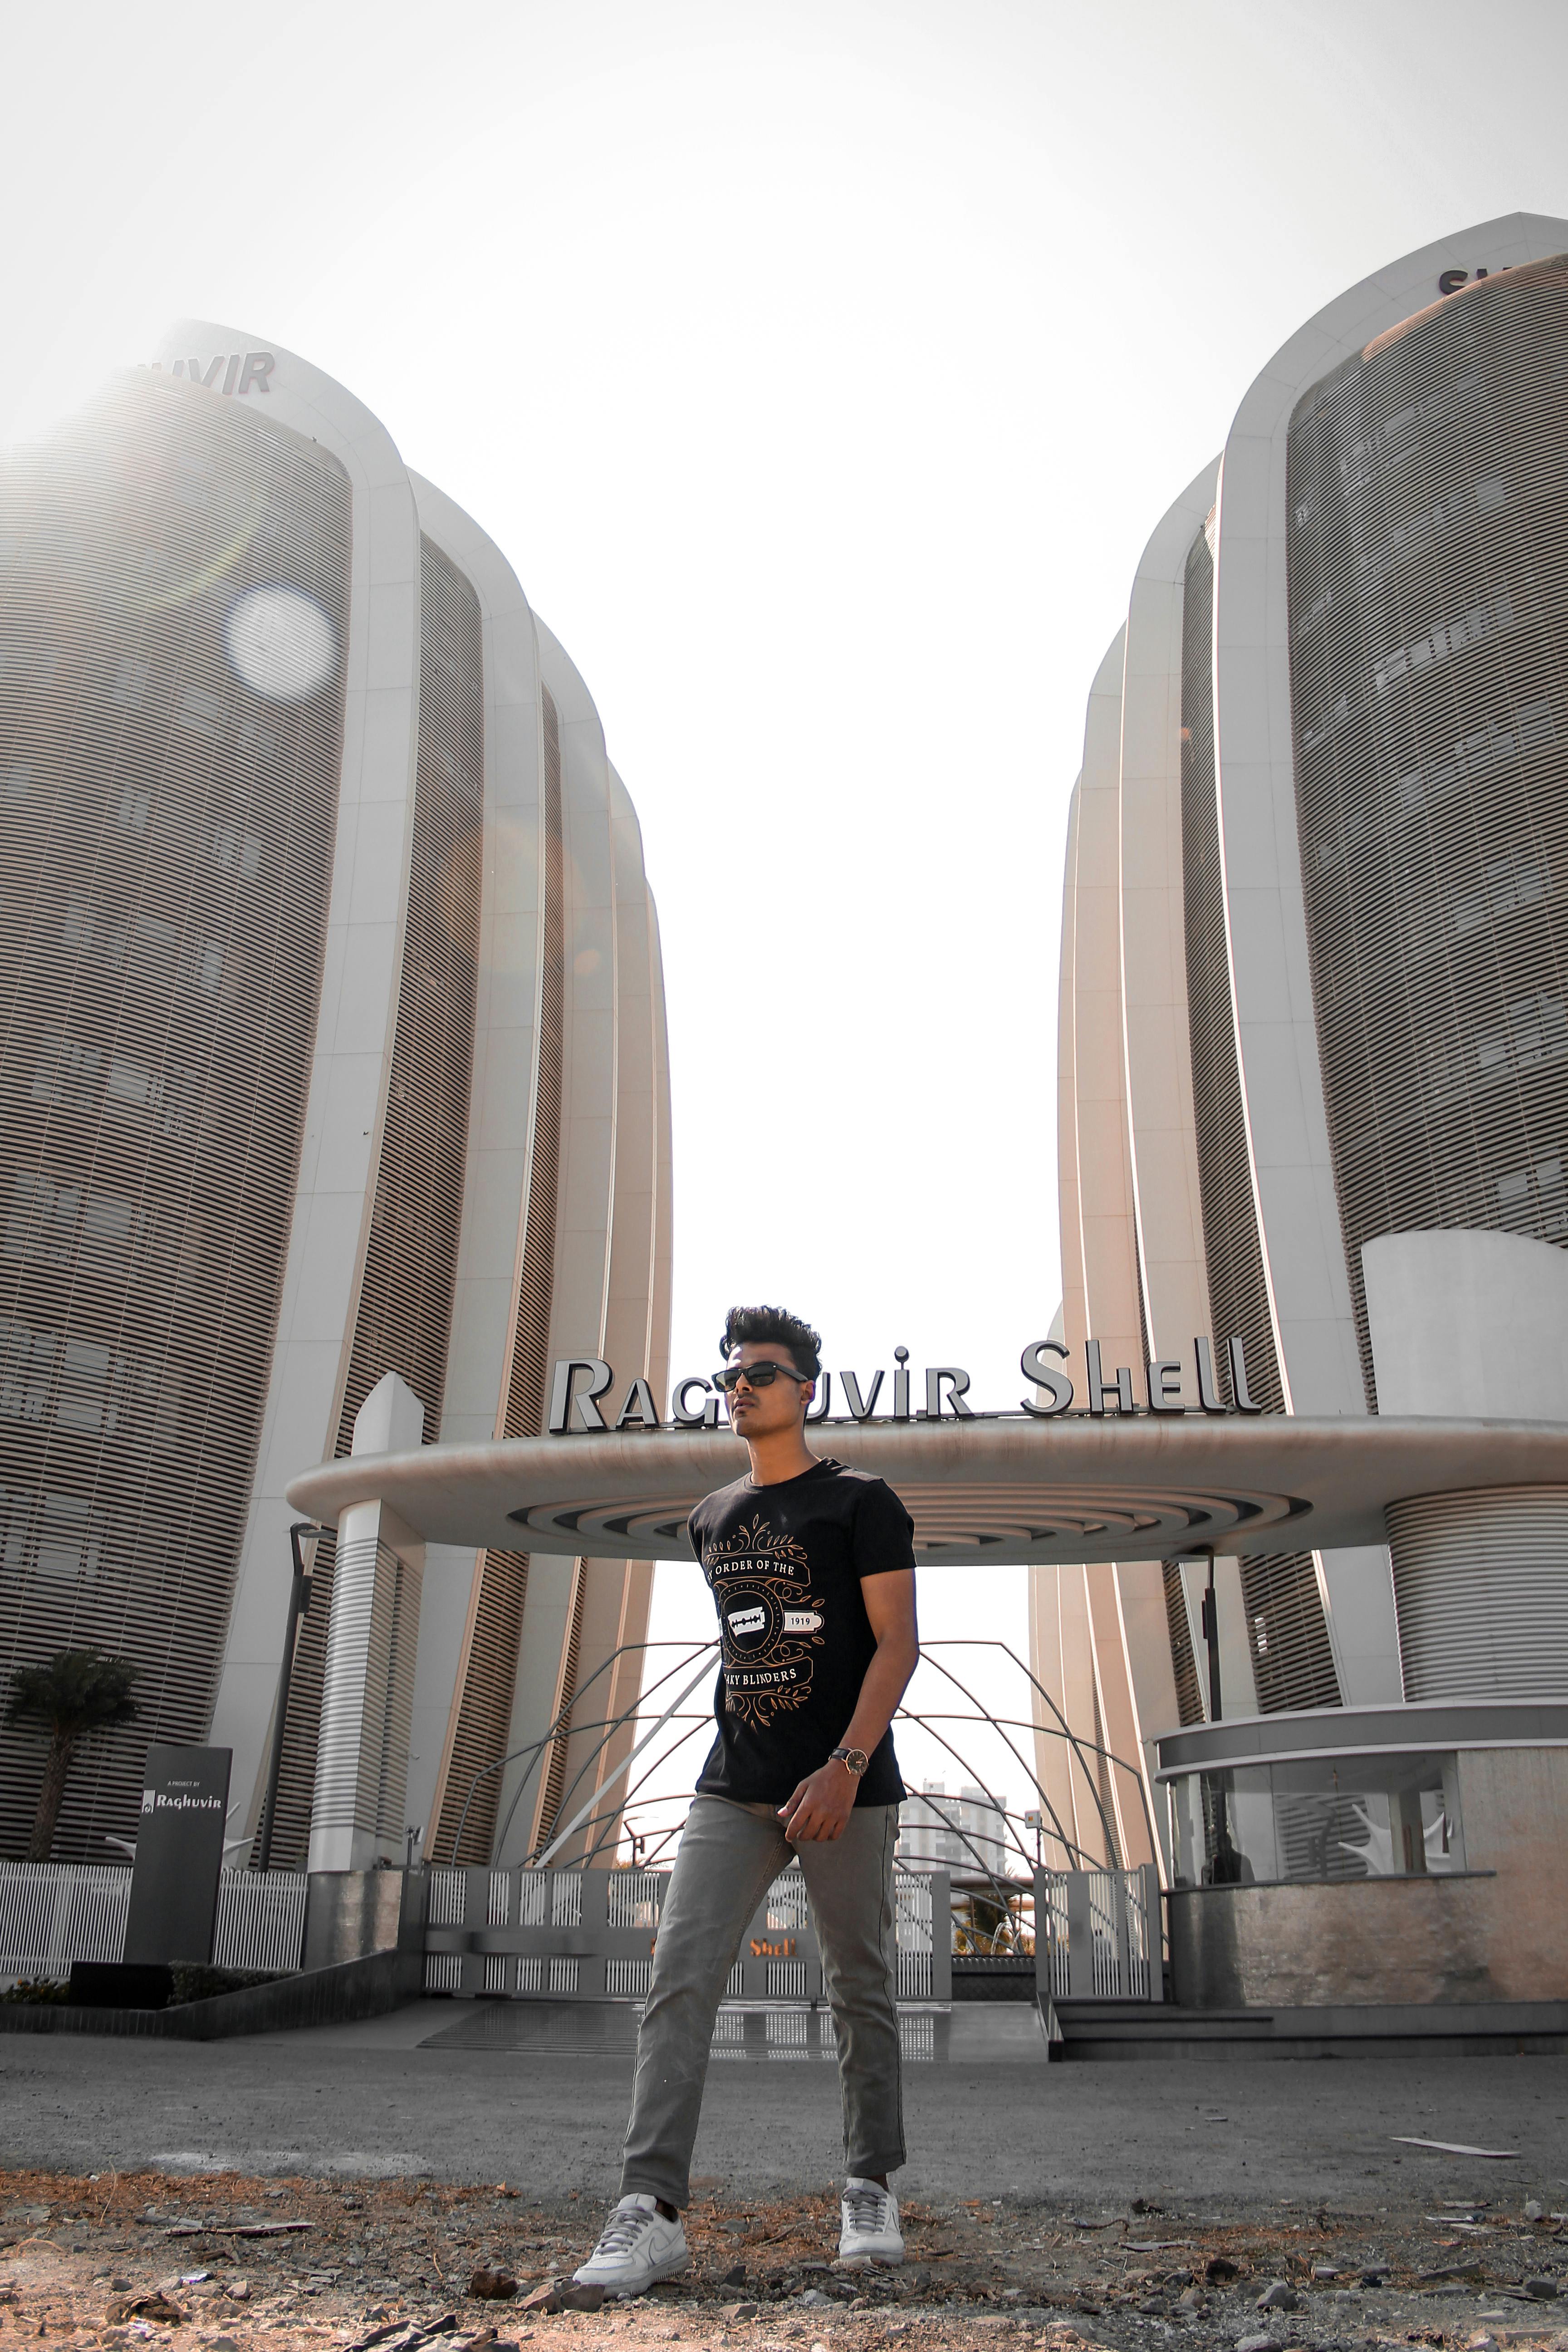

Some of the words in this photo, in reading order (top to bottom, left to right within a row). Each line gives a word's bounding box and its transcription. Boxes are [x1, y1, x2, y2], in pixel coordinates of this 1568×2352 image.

[549, 1346, 975, 1434] RAGUViR
[715, 1560, 753, 1575] ORDER
[756, 1560, 769, 1570] OF
[773, 1562, 794, 1575] THE
[791, 1617, 810, 1625] 1919
[724, 1674, 740, 1685] AKY
[743, 1668, 797, 1686] BLINDERS
